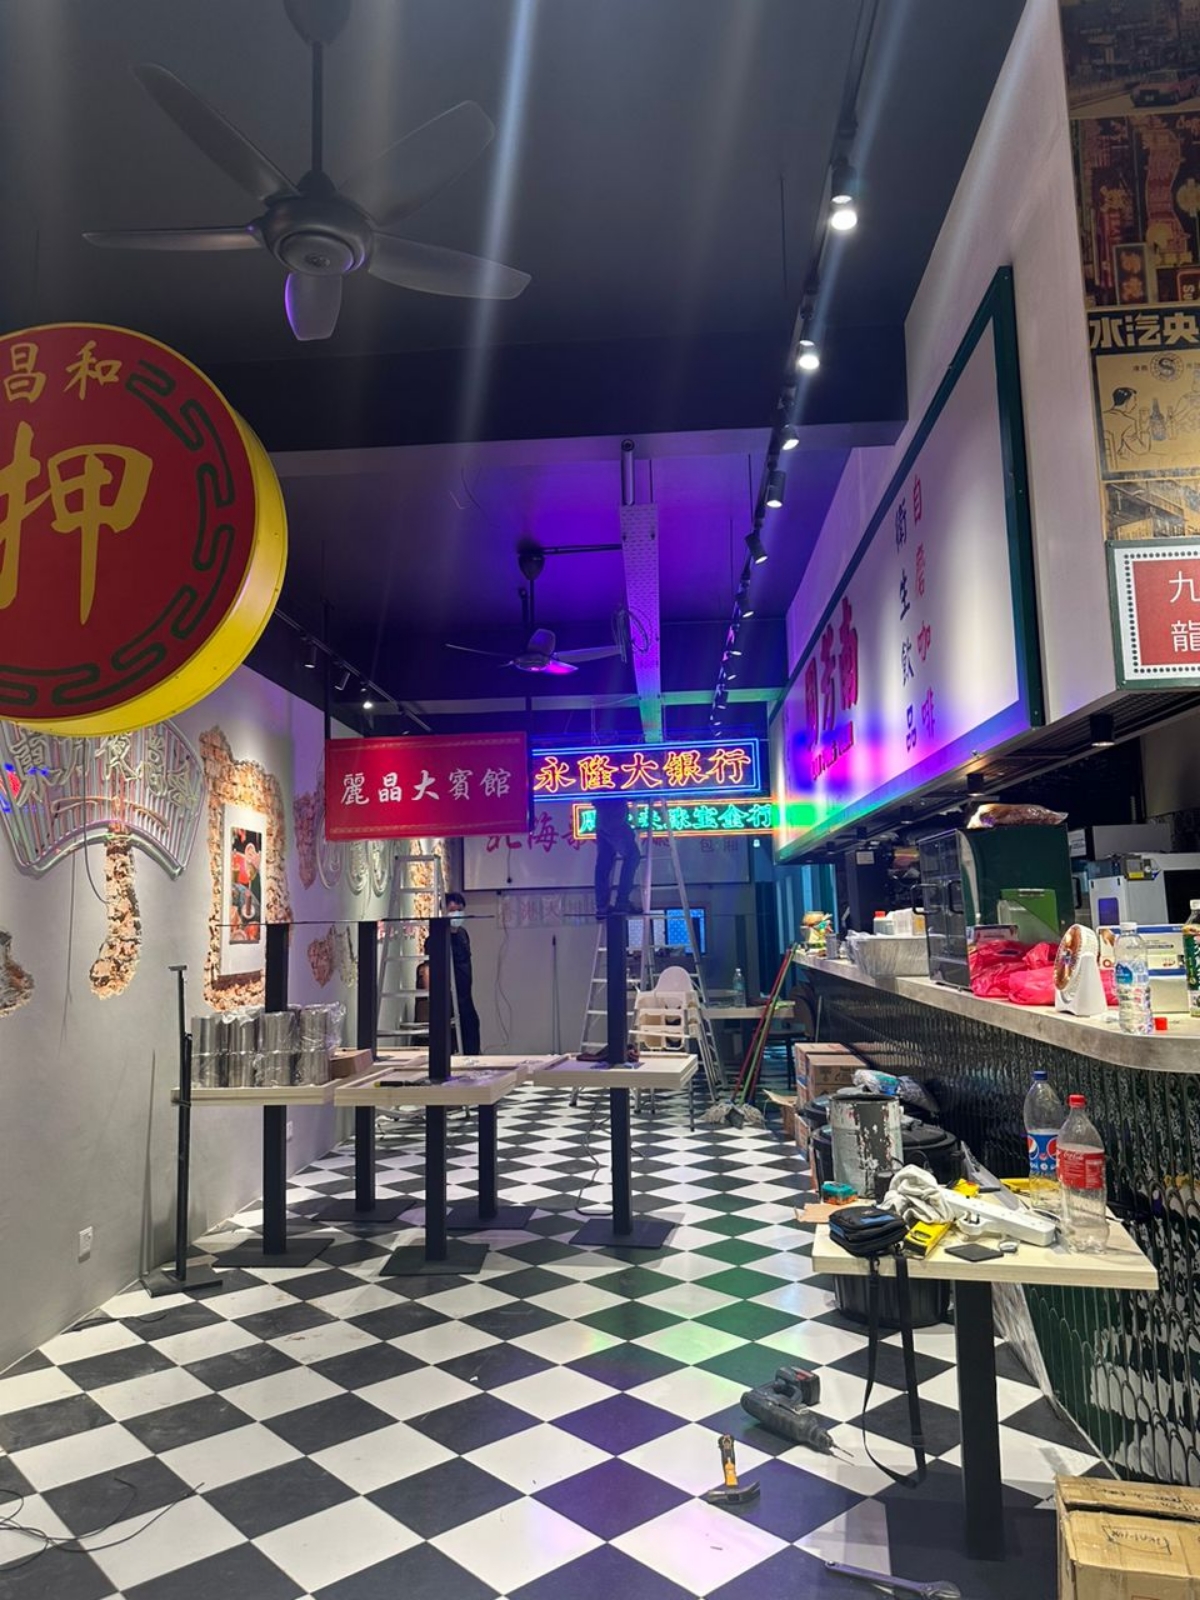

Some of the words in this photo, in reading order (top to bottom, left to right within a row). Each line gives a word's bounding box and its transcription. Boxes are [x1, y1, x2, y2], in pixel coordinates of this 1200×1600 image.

[0, 421, 153, 625] 押
[340, 768, 512, 805] 麗晶大賓館
[533, 748, 751, 793] 永隆大銀行
